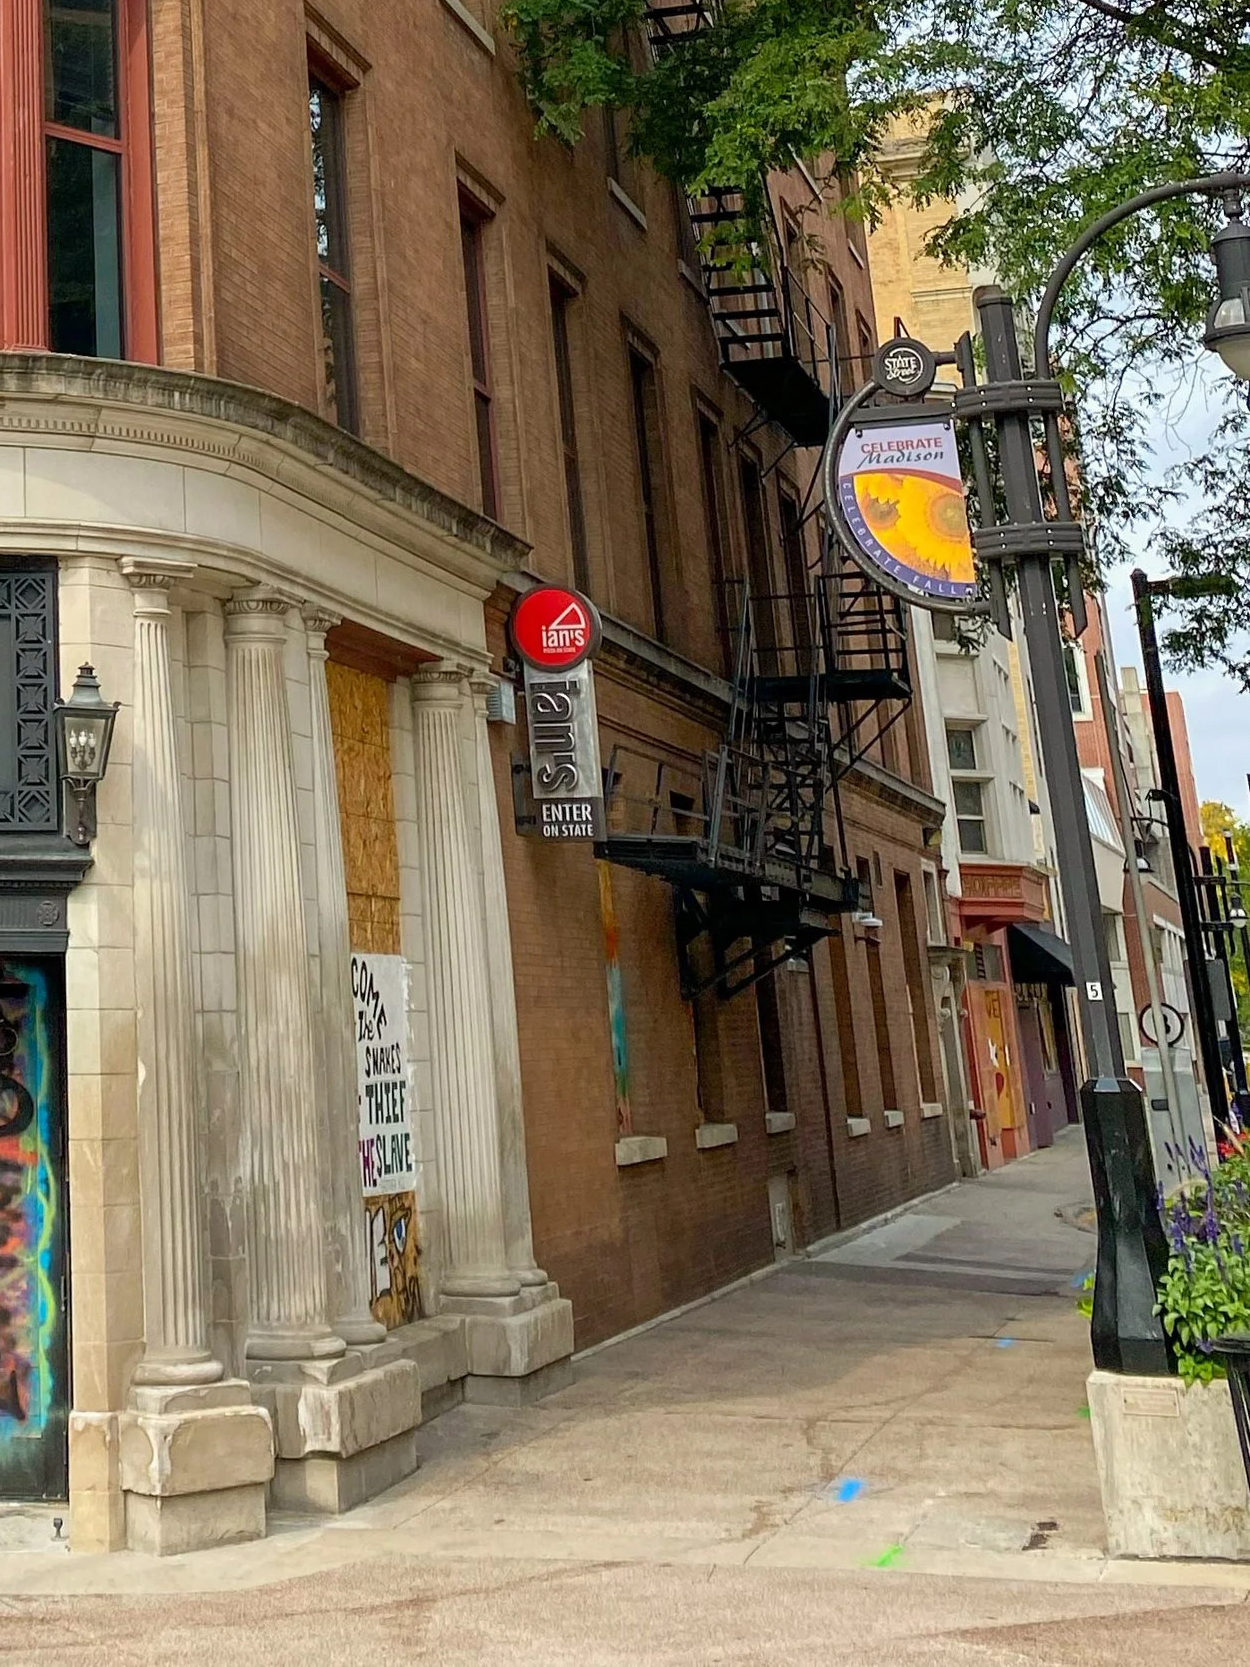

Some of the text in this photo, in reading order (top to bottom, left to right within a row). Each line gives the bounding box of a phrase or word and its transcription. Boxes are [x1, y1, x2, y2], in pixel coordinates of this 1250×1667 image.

[884, 355, 917, 370] STATE
[861, 437, 943, 454] CELEBRATE
[856, 449, 944, 470] Madison
[842, 482, 957, 595] CELEBRATE FALL
[542, 625, 585, 648] ian's
[530, 677, 579, 792] ian's
[542, 803, 592, 822] ENTER
[543, 824, 594, 837] ON STATE
[1090, 985, 1099, 998] 5
[365, 1081, 406, 1125] THIEF
[358, 1133, 412, 1188] HE SLAVE
